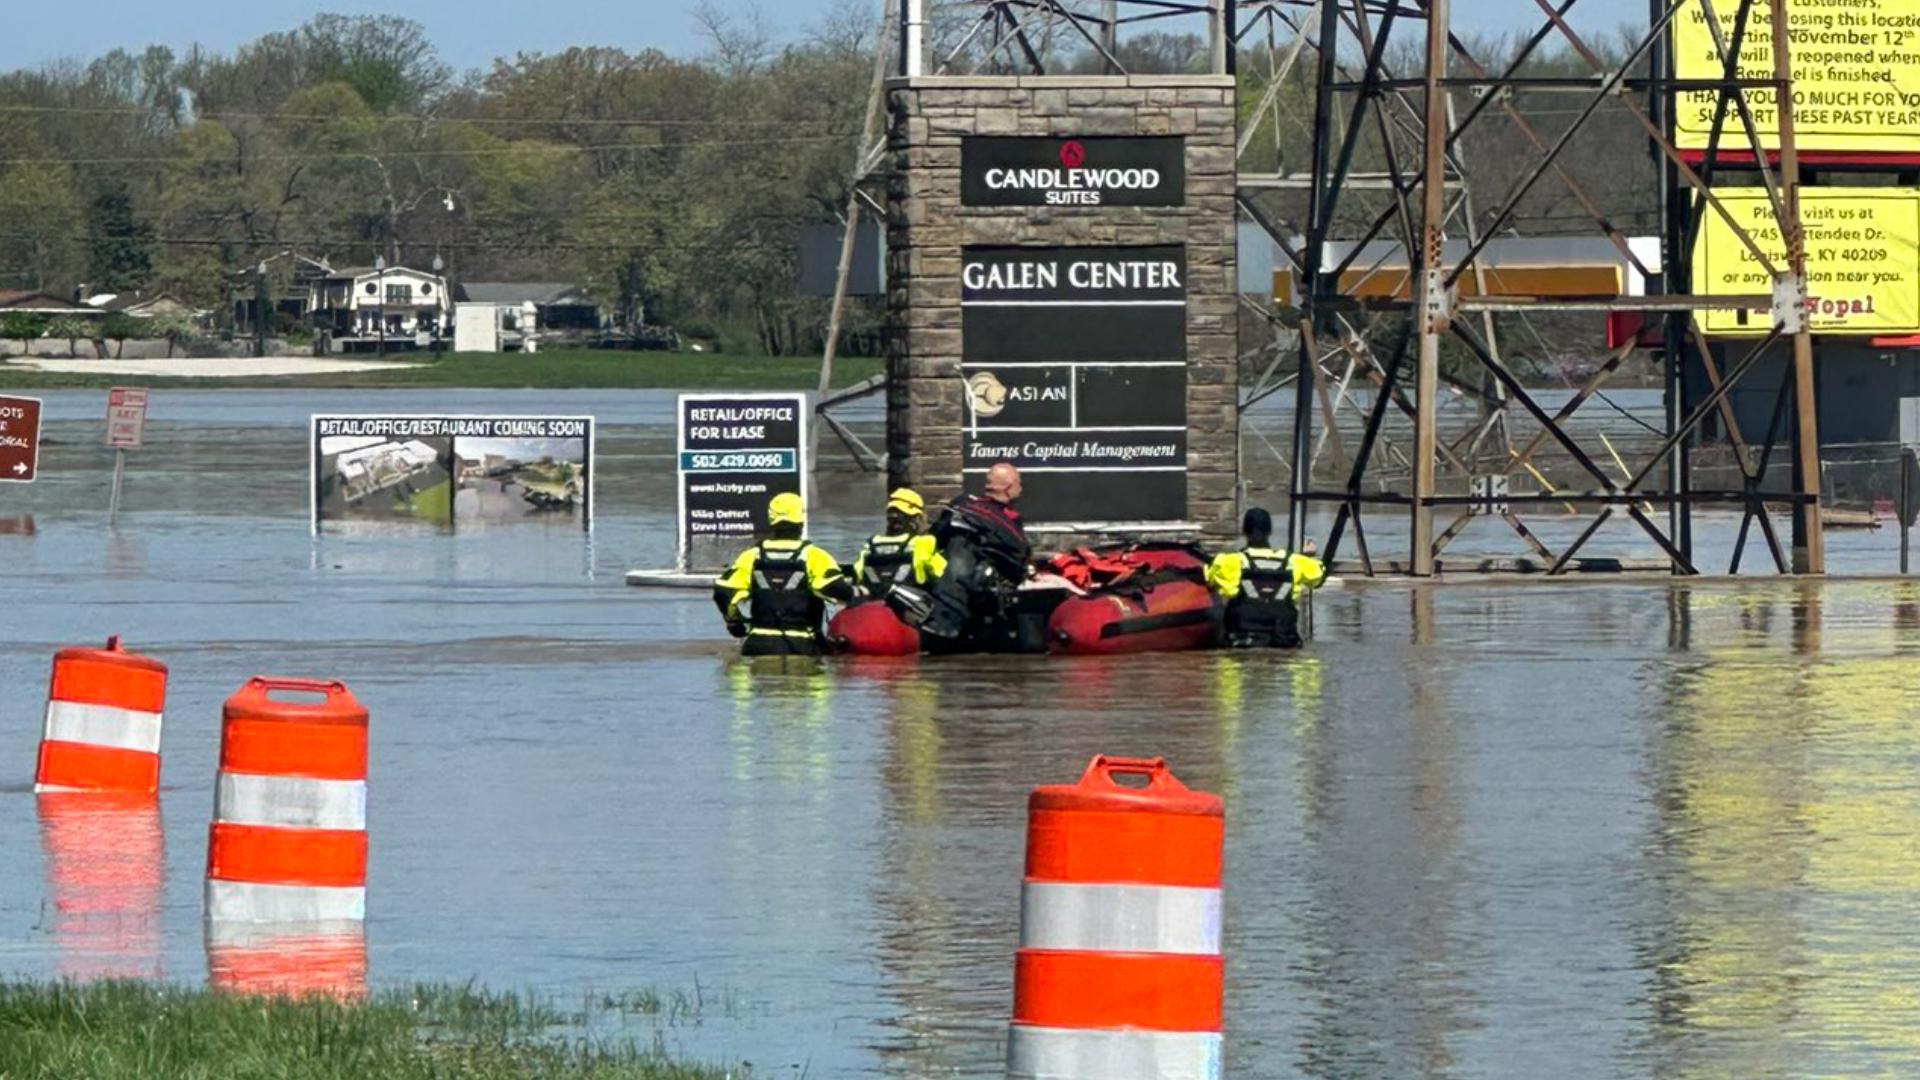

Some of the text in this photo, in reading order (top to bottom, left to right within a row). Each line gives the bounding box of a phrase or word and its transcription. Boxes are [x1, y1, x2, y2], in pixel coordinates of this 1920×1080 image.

[1838, 12, 1868, 26] this
[1797, 50, 1874, 66] reopened
[1810, 67, 1824, 81] is
[1809, 91, 1859, 106] MUCH
[1863, 92, 1895, 106] FOR
[1833, 110, 1873, 125] PAST
[1877, 111, 1920, 126] YEAR
[984, 168, 1160, 189] CANDLEWOOD
[1045, 190, 1100, 205] SUITES
[1804, 206, 1834, 220] visit
[1839, 208, 1855, 219] us
[1858, 208, 1874, 219] at
[1864, 227, 1887, 241] Dr.
[1818, 248, 1837, 261] KY
[1841, 248, 1888, 262] 40209
[963, 261, 1181, 290] GALEN CENTER
[1722, 273, 1740, 283] or
[1743, 273, 1768, 285] any
[1872, 271, 1904, 286] you.
[690, 407, 793, 421] RETAIL/OFFICE
[494, 421, 545, 436] COMING
[548, 421, 584, 436] SOON
[690, 425, 766, 440] FOR LEASE
[970, 442, 1177, 462] Taurus Capital Management
